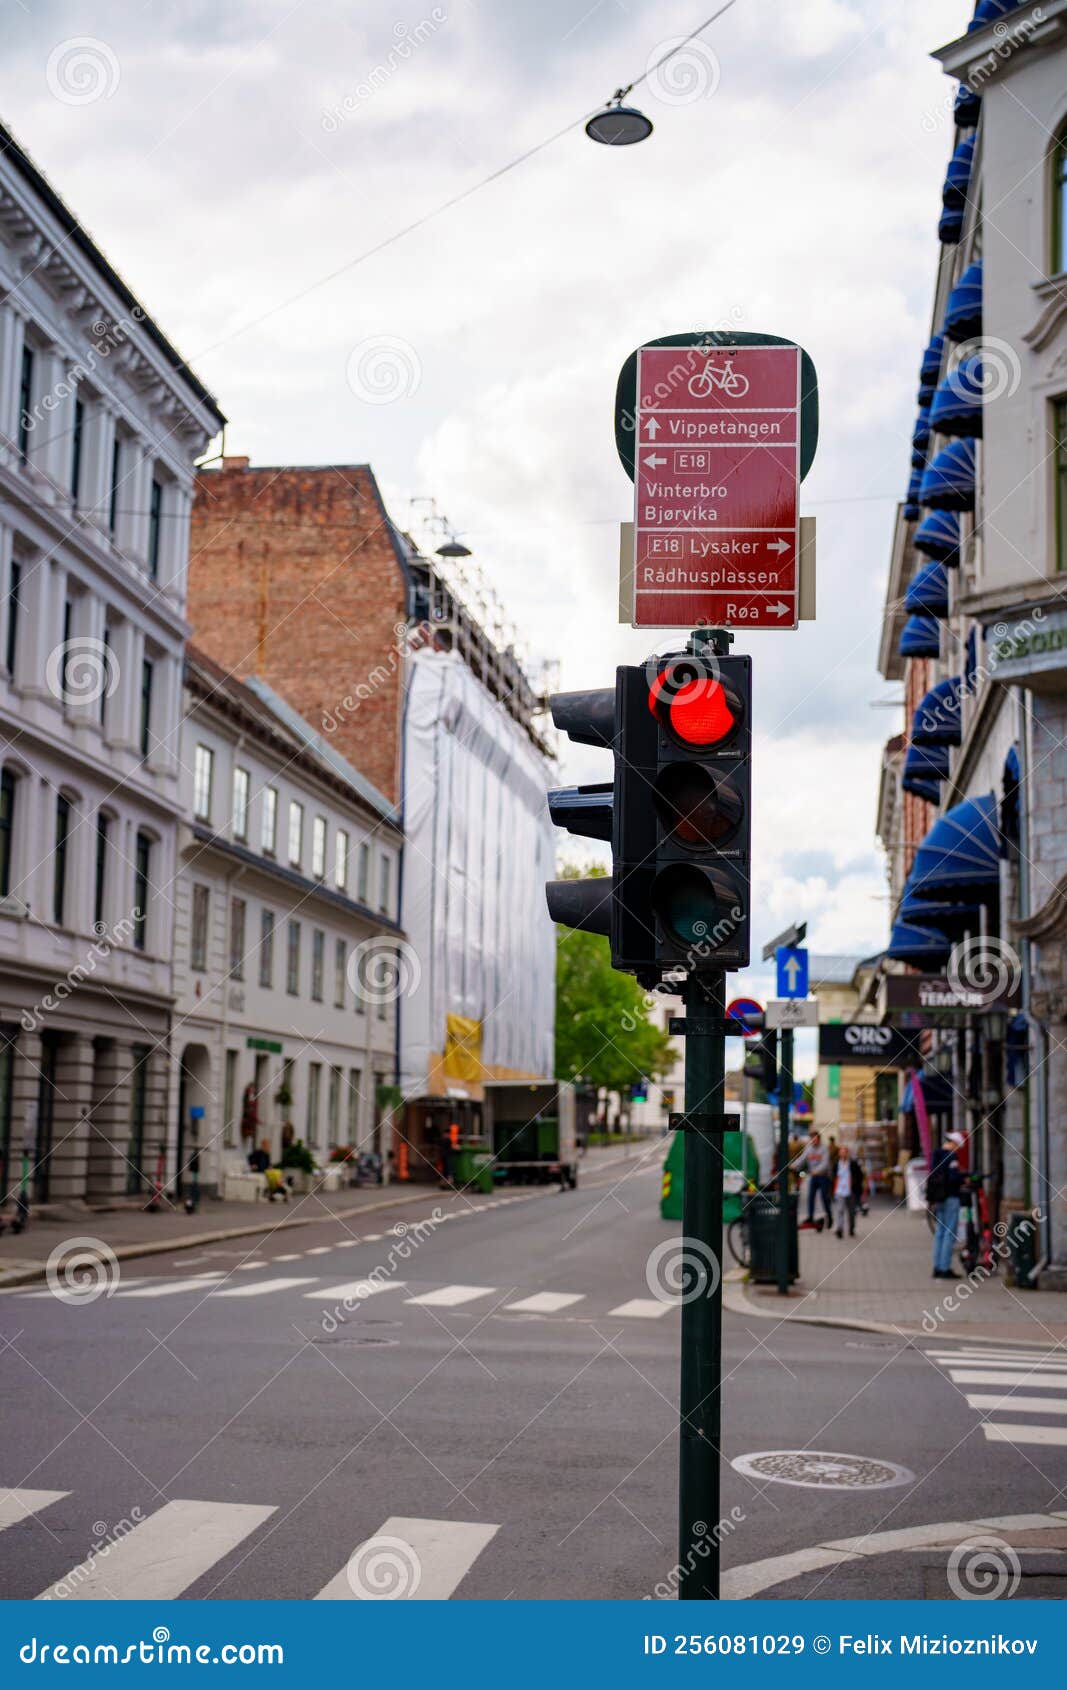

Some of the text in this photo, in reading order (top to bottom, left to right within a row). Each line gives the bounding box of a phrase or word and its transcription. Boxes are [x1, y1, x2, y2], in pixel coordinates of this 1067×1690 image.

[669, 419, 781, 438] Vippetangen
[679, 454, 706, 468] E18
[646, 482, 728, 499] Vinterbro
[645, 505, 718, 524] Bjørvika
[653, 539, 760, 557] E18 Lysaker
[643, 566, 779, 586] Rådhusplassen
[726, 603, 759, 619] Røa
